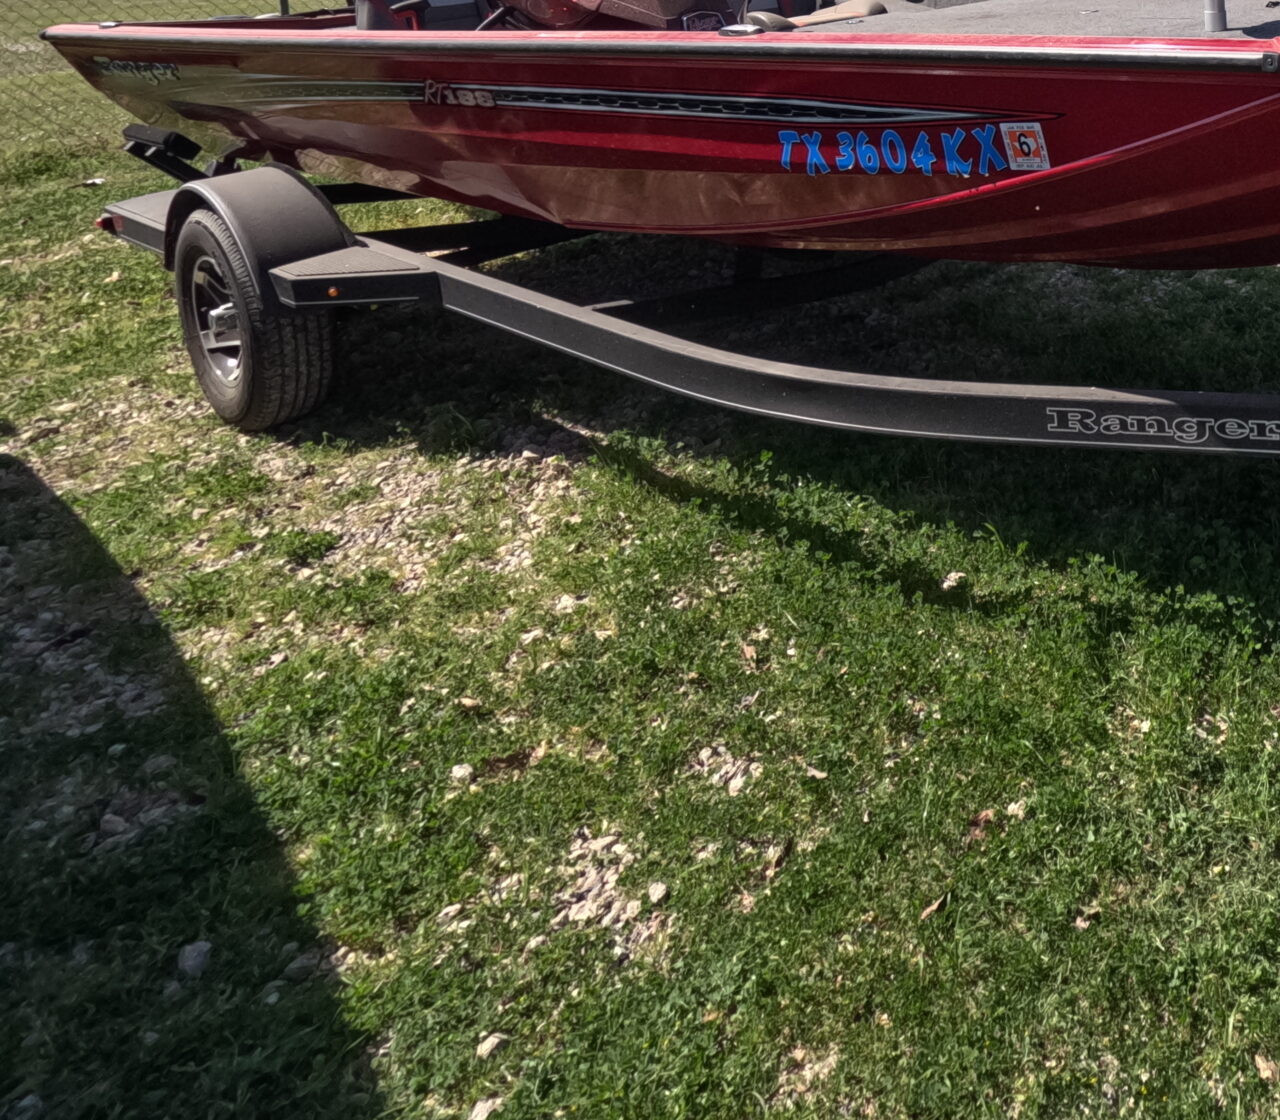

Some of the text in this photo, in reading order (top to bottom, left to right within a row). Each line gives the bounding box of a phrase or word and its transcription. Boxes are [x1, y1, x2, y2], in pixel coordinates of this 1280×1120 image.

[778, 130, 831, 177] TX
[835, 129, 937, 177] 3604
[940, 123, 1008, 179] KX
[1017, 132, 1032, 157] 6
